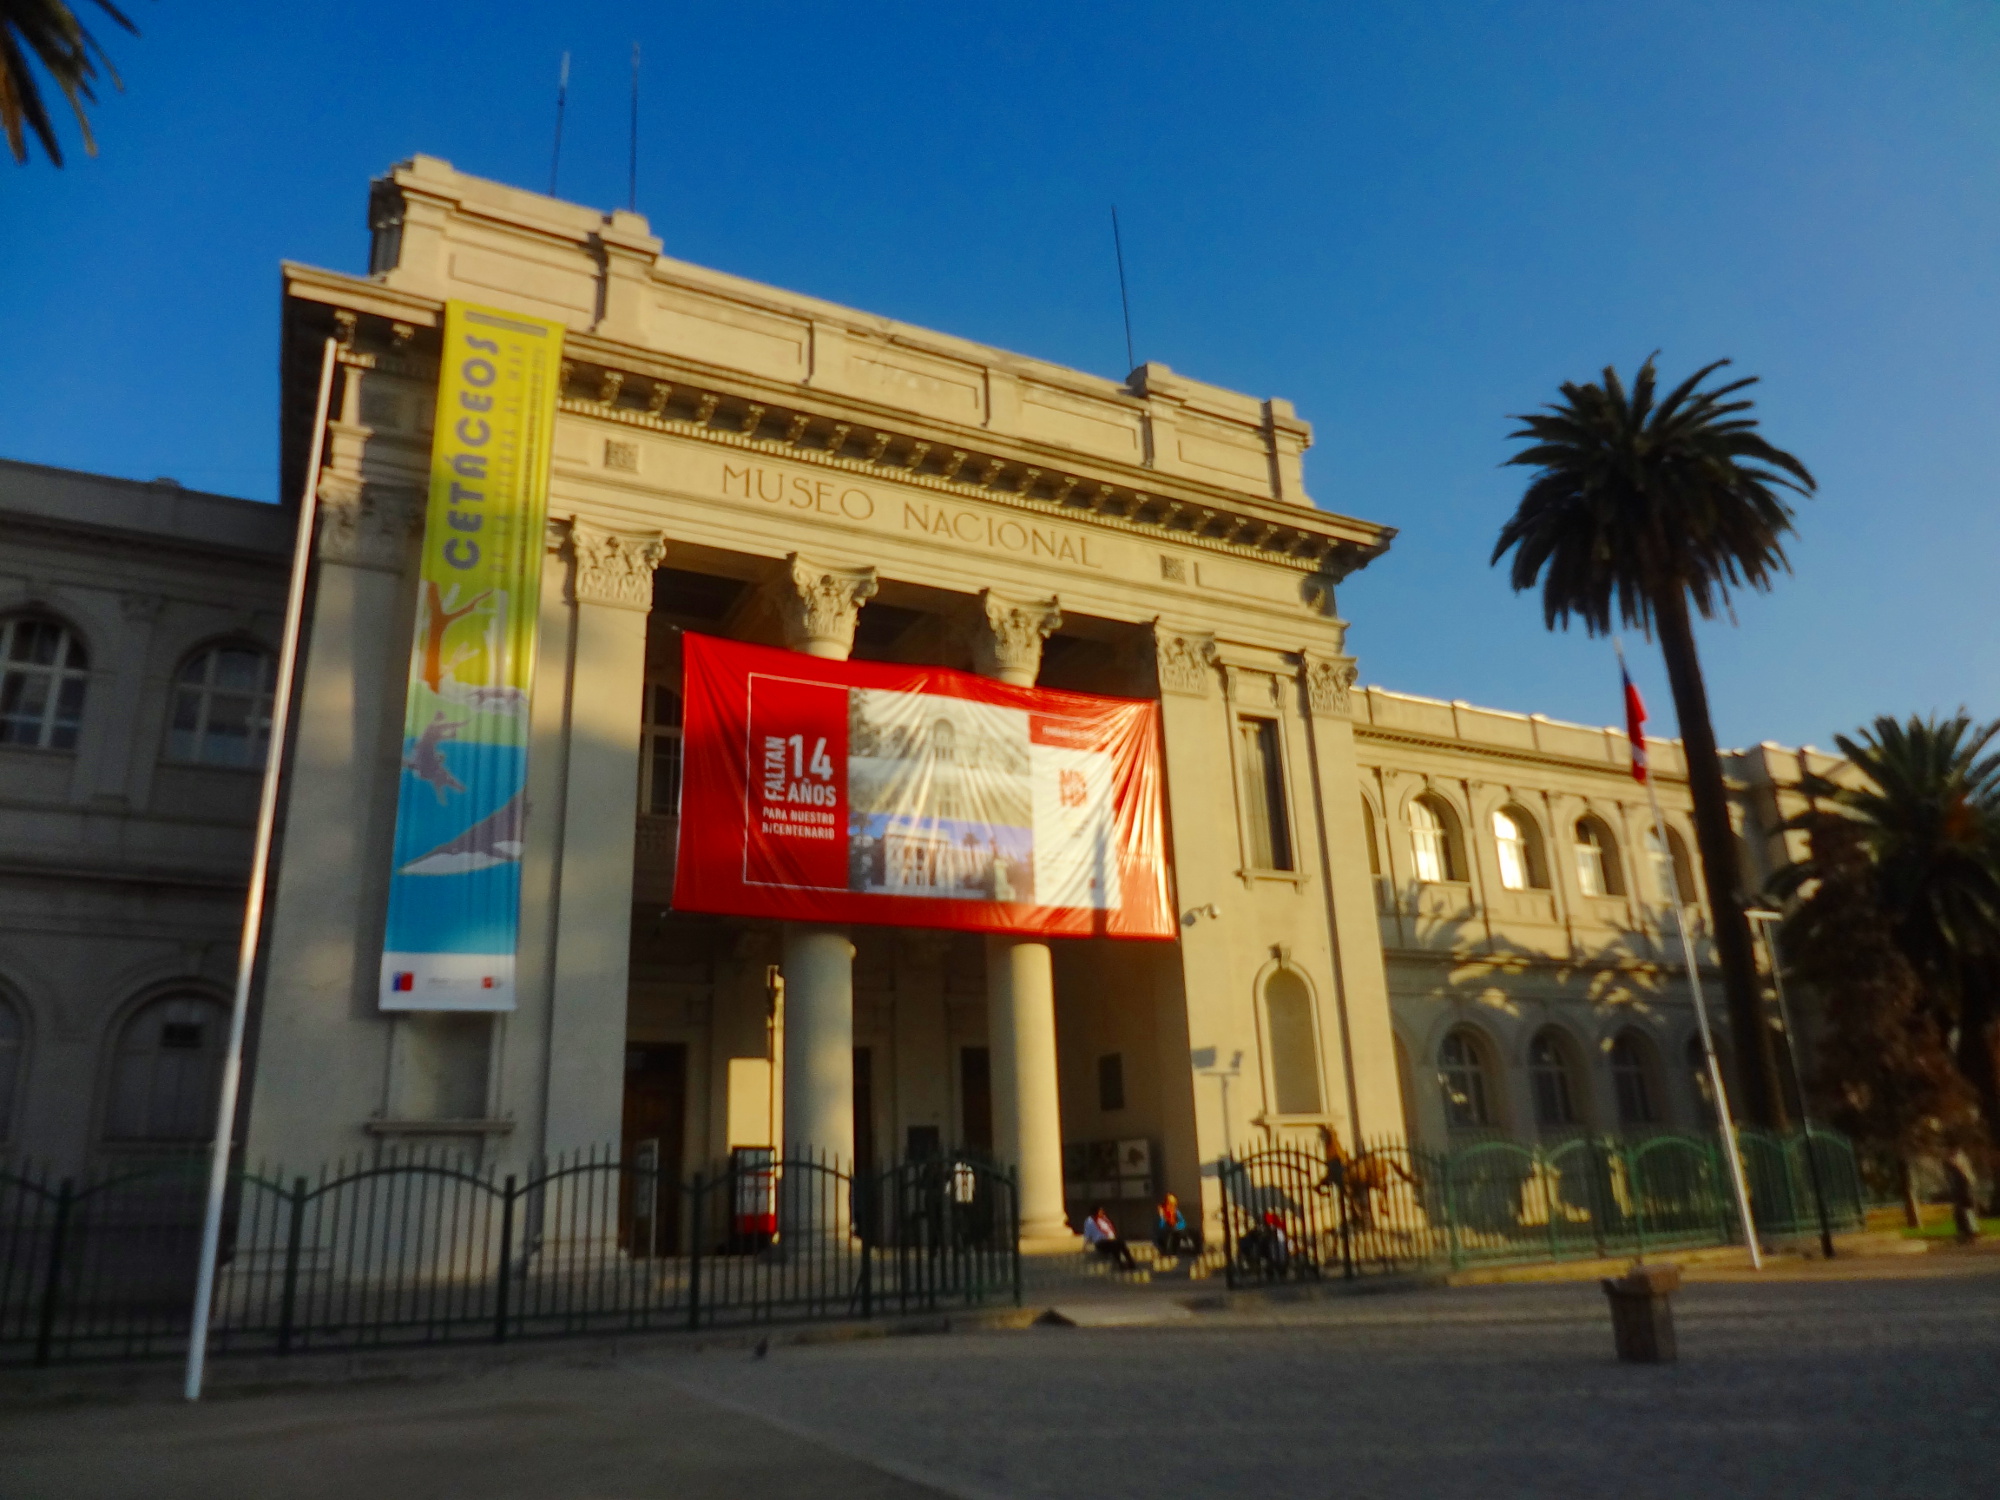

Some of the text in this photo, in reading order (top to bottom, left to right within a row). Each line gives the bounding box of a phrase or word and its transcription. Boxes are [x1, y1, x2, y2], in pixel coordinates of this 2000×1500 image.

[442, 333, 499, 571] CETÁCEOS
[722, 463, 1103, 568] MUSEO NACIONAL
[764, 735, 786, 801] FALTAN
[788, 734, 834, 781] 14
[763, 806, 835, 825] PARA NUESTRO
[787, 778, 837, 807] AÑOS
